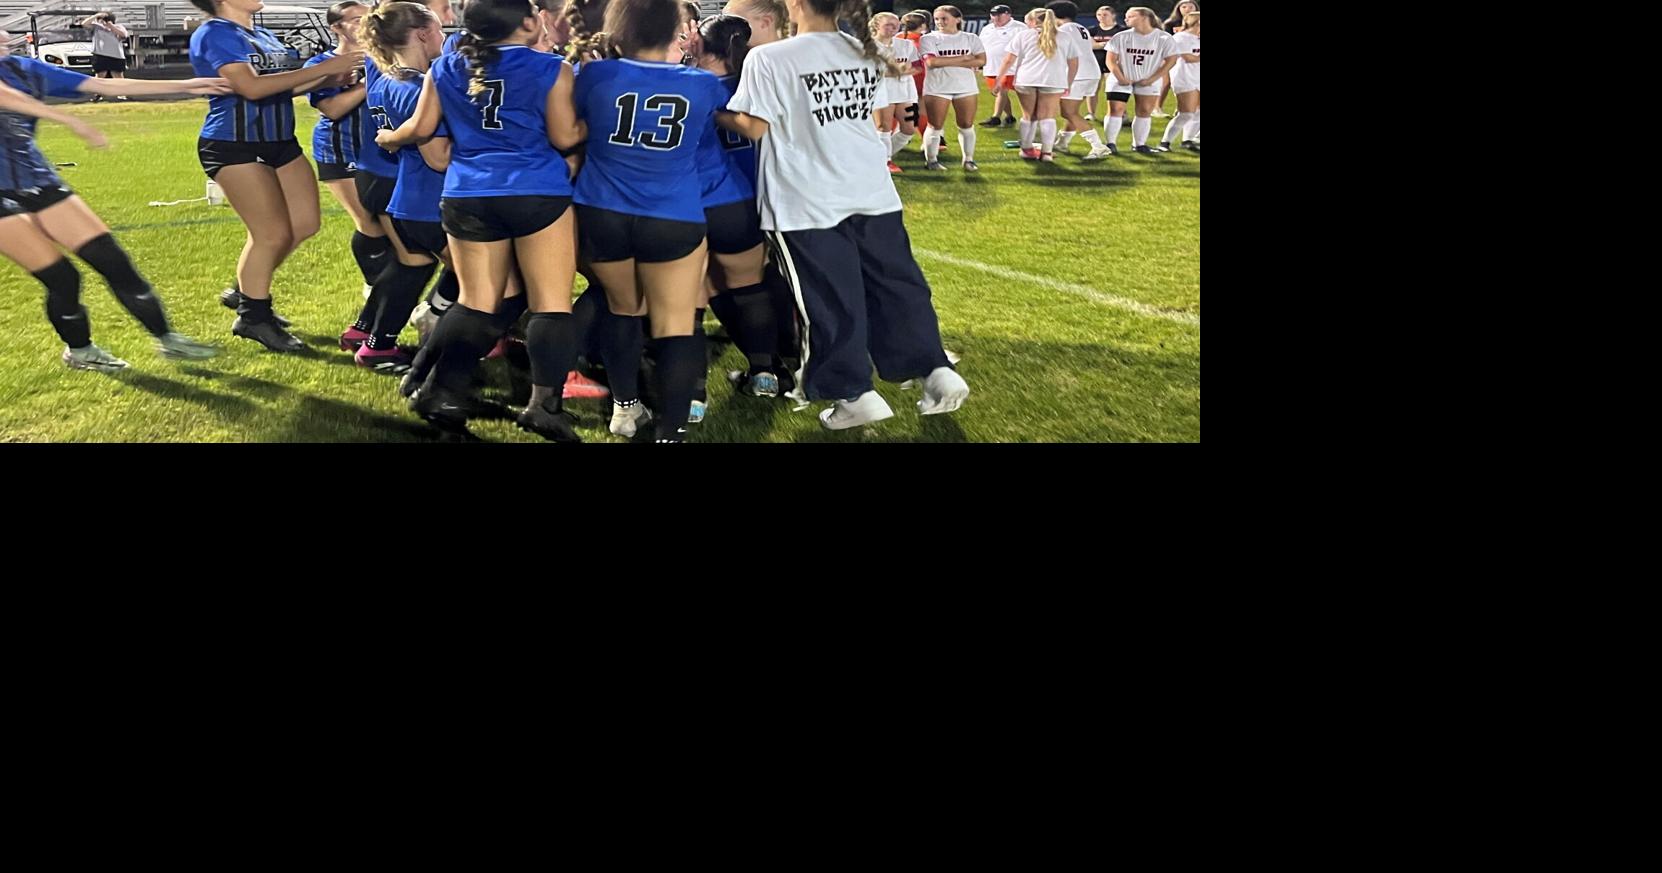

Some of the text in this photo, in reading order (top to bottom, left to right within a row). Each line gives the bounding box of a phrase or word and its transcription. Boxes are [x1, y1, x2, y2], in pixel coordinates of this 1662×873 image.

[1132, 55, 1145, 65] 12
[839, 86, 877, 101] THE
[608, 92, 690, 151] 13
